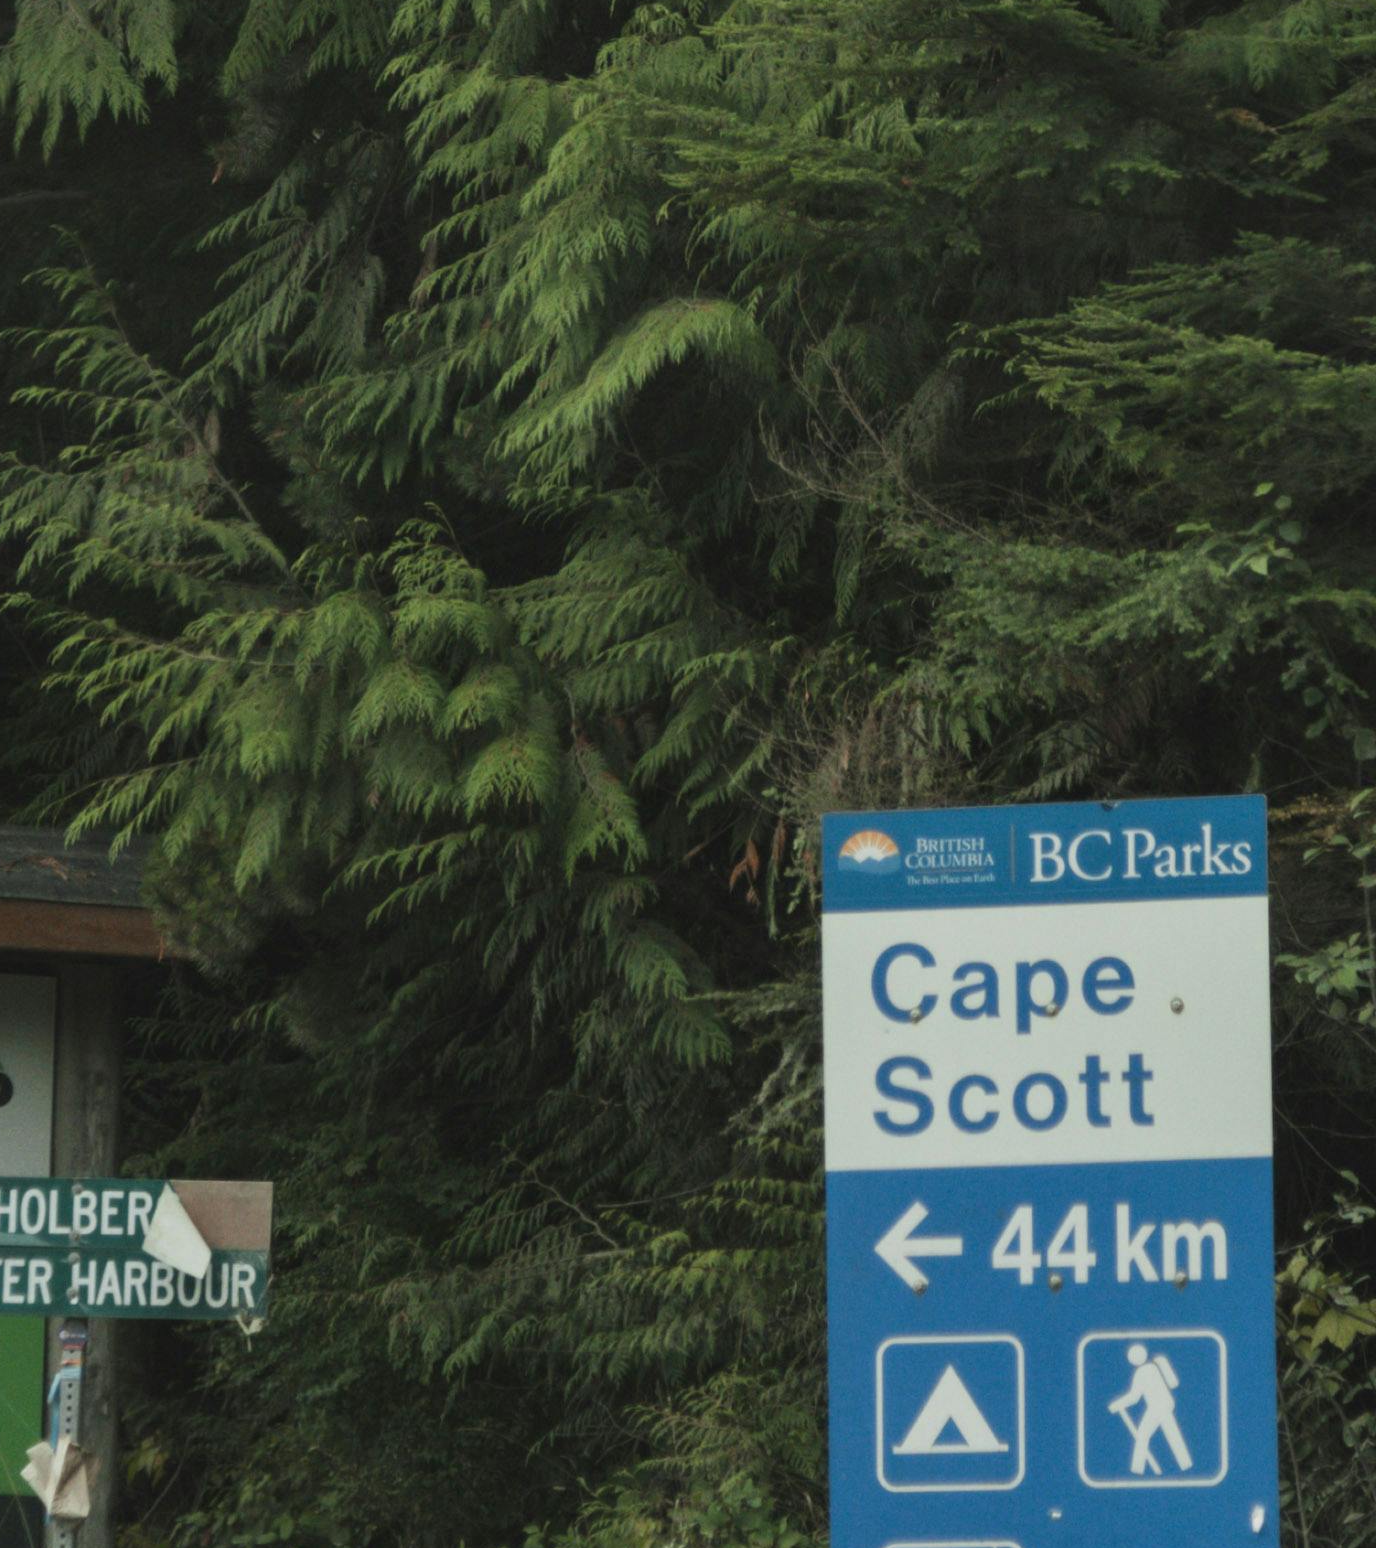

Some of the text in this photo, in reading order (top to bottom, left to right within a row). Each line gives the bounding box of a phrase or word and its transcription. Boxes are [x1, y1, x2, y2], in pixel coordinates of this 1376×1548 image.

[904, 852, 995, 869] COLUMBIA
[915, 837, 985, 853] BRITISH
[1028, 822, 1252, 883] BC Parks
[907, 875, 921, 886] The
[870, 941, 1137, 1037] Cape
[870, 1050, 1156, 1138] Scott
[990, 1199, 1229, 1286] 44 km
[71, 1258, 256, 1308] HARBOUR
